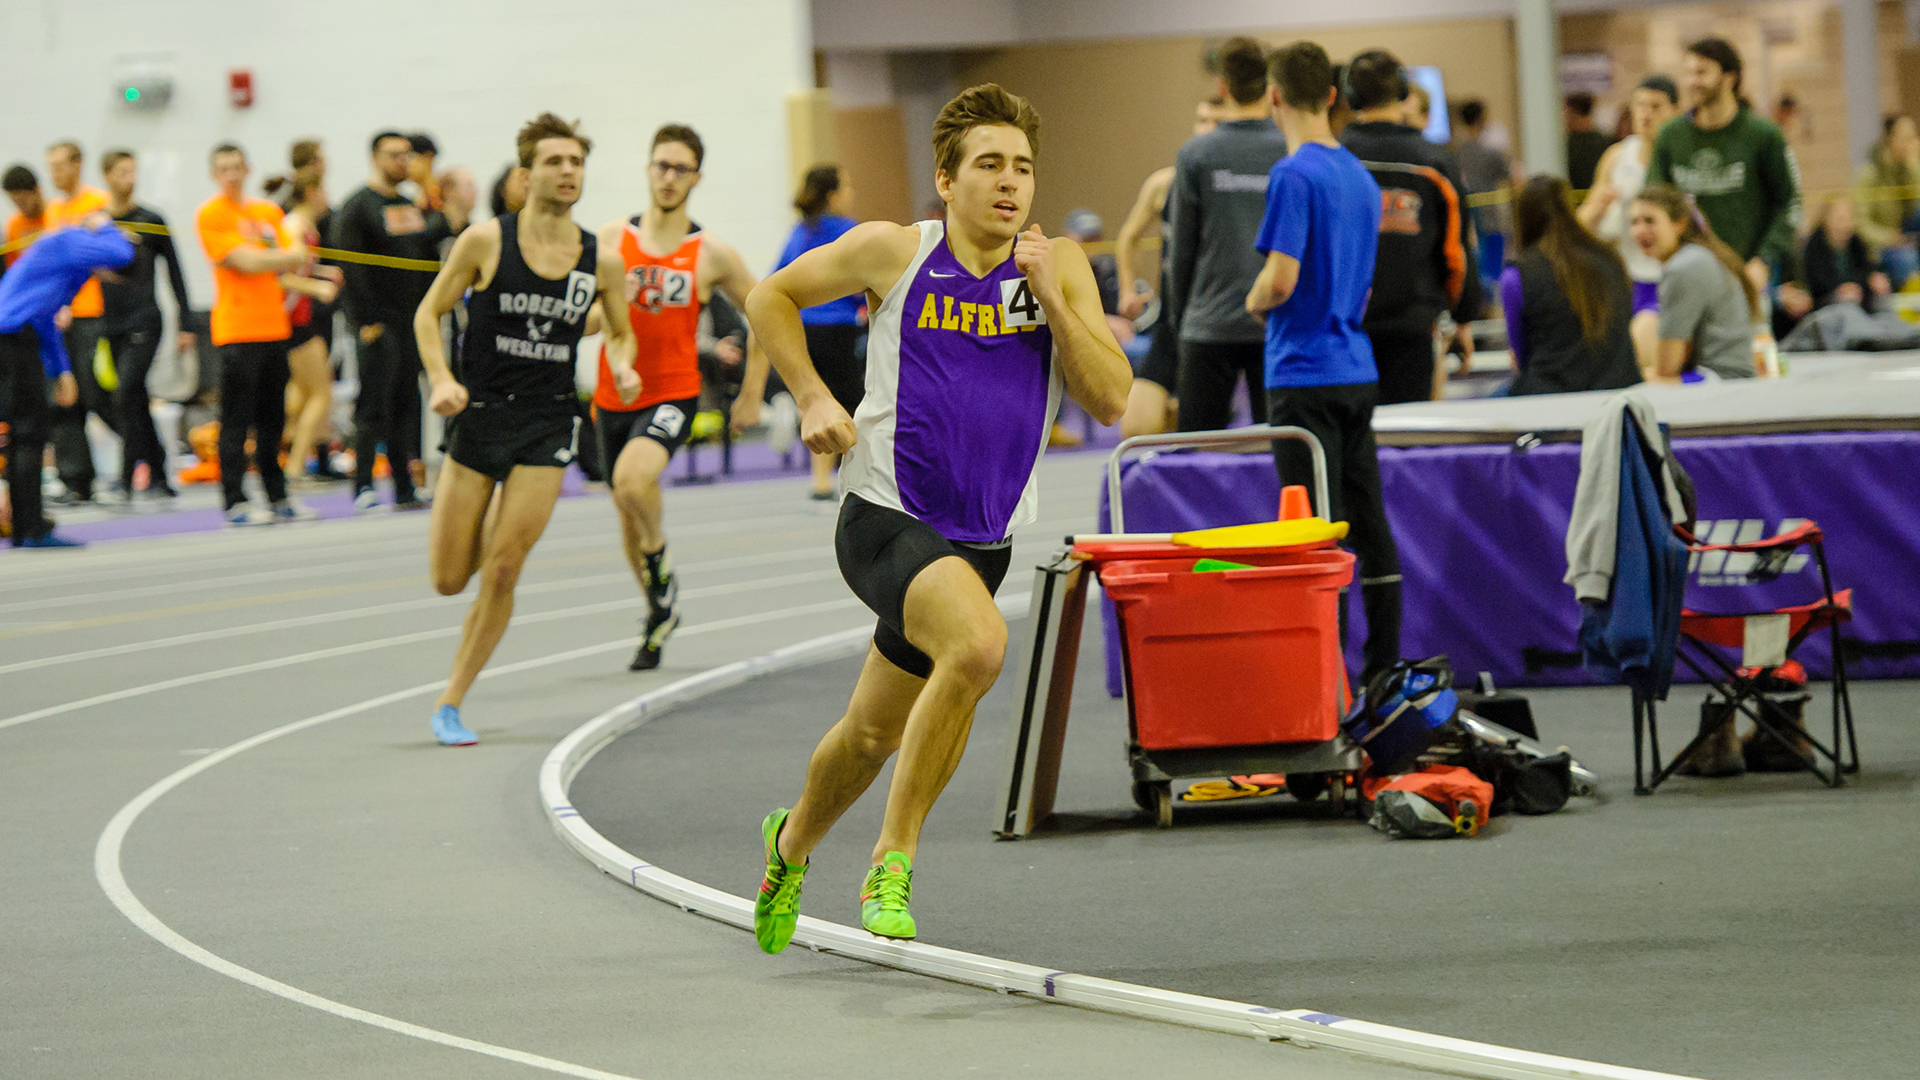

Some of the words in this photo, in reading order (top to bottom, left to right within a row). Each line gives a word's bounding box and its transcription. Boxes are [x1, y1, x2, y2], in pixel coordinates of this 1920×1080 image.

[572, 278, 588, 307] 6
[669, 275, 686, 302] 2
[1008, 279, 1040, 321] 4
[917, 292, 1038, 336] ALFRE
[1687, 518, 1810, 574] ILL
